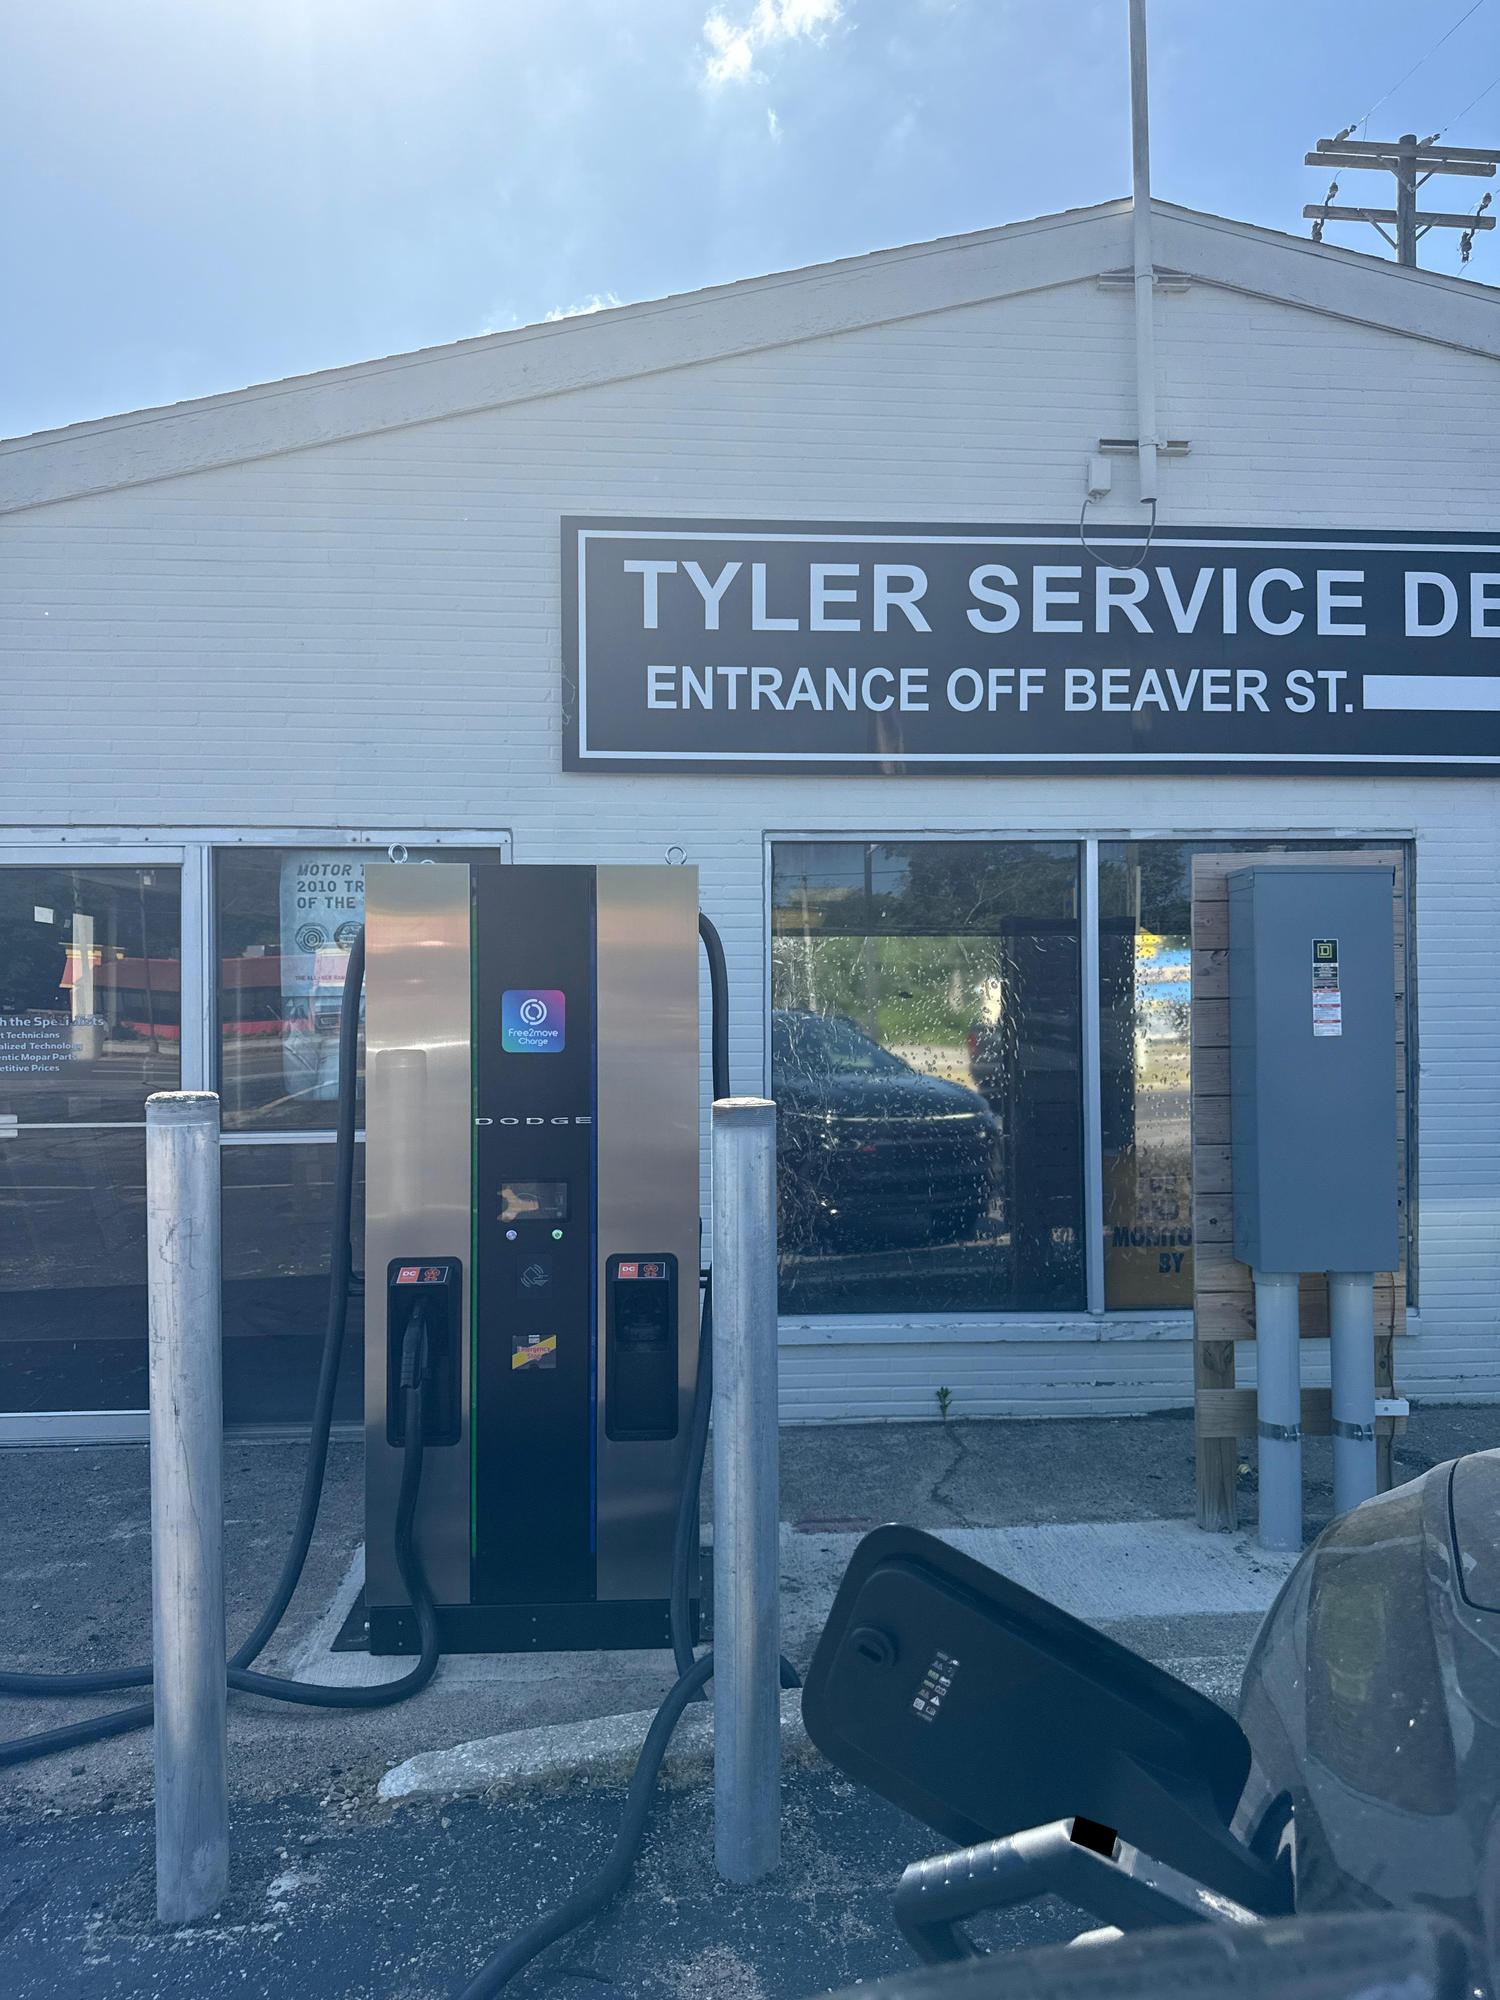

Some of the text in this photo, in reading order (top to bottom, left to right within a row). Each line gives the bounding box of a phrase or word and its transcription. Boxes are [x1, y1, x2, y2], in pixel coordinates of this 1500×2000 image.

[624, 560, 1500, 637] TYLER SERVICE DE
[647, 666, 1353, 713] ENTRANCE OFF BEAVER ST.
[296, 864, 352, 876] MOTOR
[297, 880, 364, 893] 2010 TR
[297, 896, 356, 909] OF THE
[9, 1016, 31, 1026] the
[33, 1016, 104, 1028] Speilists
[6, 1031, 60, 1039] Technicians
[508, 1028, 559, 1037] Free2move
[518, 1037, 549, 1047] Charge
[21, 1053, 50, 1062] Mopar
[31, 1064, 60, 1072] Prices
[475, 1117, 593, 1126] DODGE
[1159, 1252, 1185, 1274] BY
